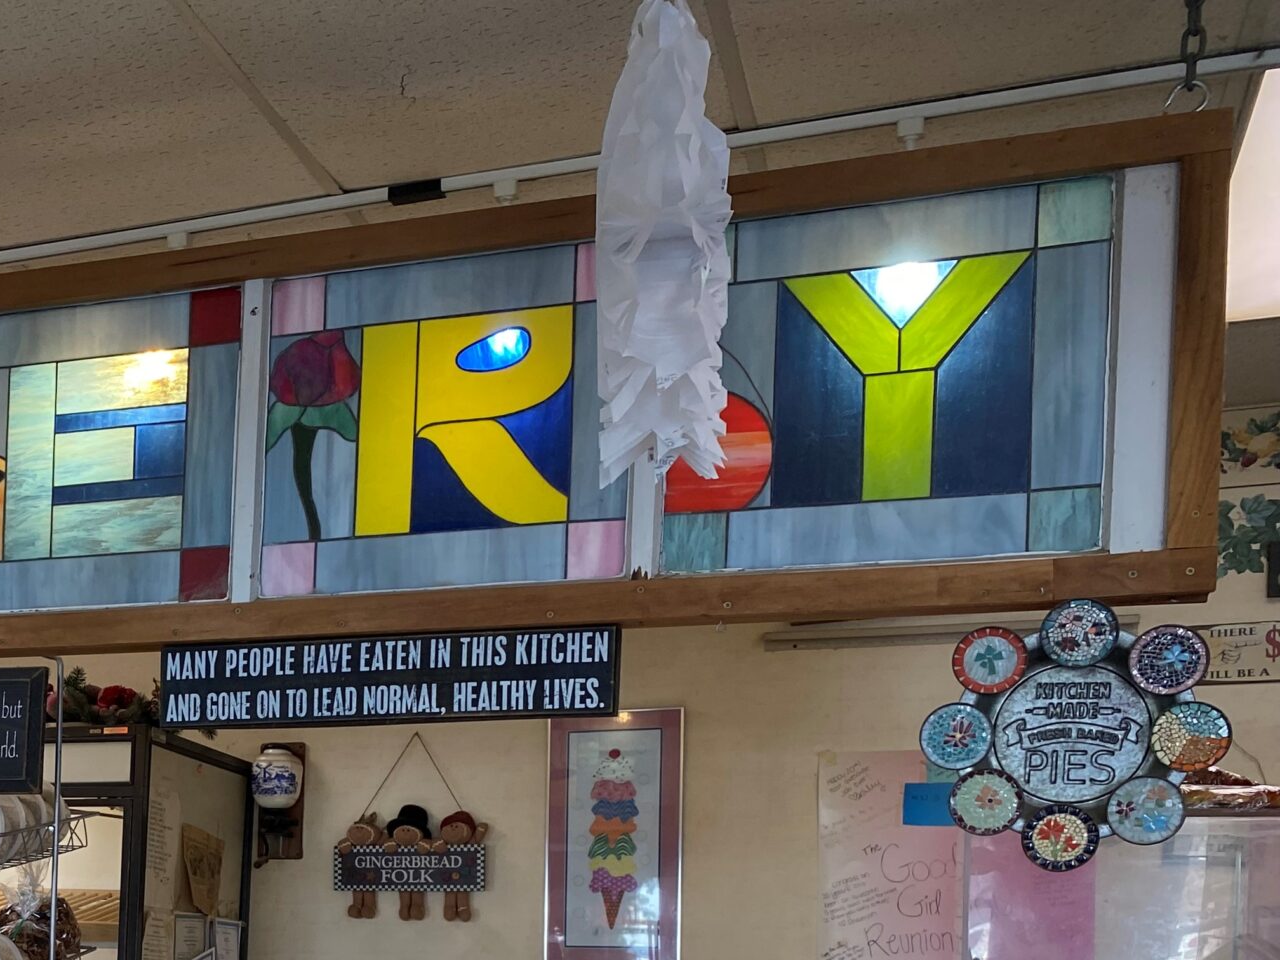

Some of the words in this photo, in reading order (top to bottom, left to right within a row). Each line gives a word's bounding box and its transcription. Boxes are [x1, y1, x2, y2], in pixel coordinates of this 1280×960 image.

[1210, 627, 1257, 638] THERE
[166, 650, 218, 681] MANY
[225, 646, 295, 678] PEOPLE
[302, 643, 352, 673] HAVE
[359, 640, 422, 672] EATEN
[429, 638, 451, 669] IN
[460, 635, 507, 667] THIS
[515, 631, 609, 665] KITCHEN
[1237, 669, 1255, 678] BE
[1259, 667, 1270, 677] A
[166, 693, 201, 722] AND
[205, 691, 251, 720] GONE
[256, 689, 280, 719] ON
[286, 688, 307, 718] TO
[313, 685, 357, 717] LEAD
[363, 682, 446, 716] NORMAL,
[453, 679, 537, 712] HEALTHY
[543, 677, 605, 710] LIVES.
[1035, 682, 1111, 700] KITCHEN
[1, 690, 22, 719] but
[1046, 702, 1099, 719] MADE
[1027, 727, 1072, 744] FRESH
[1077, 728, 1120, 744] BAKED
[1024, 749, 1116, 785] PIES
[354, 855, 462, 869] GINGERBREAD
[381, 869, 434, 884] FOLK
[897, 885, 942, 918] Girl
[864, 922, 955, 958] Reunion
